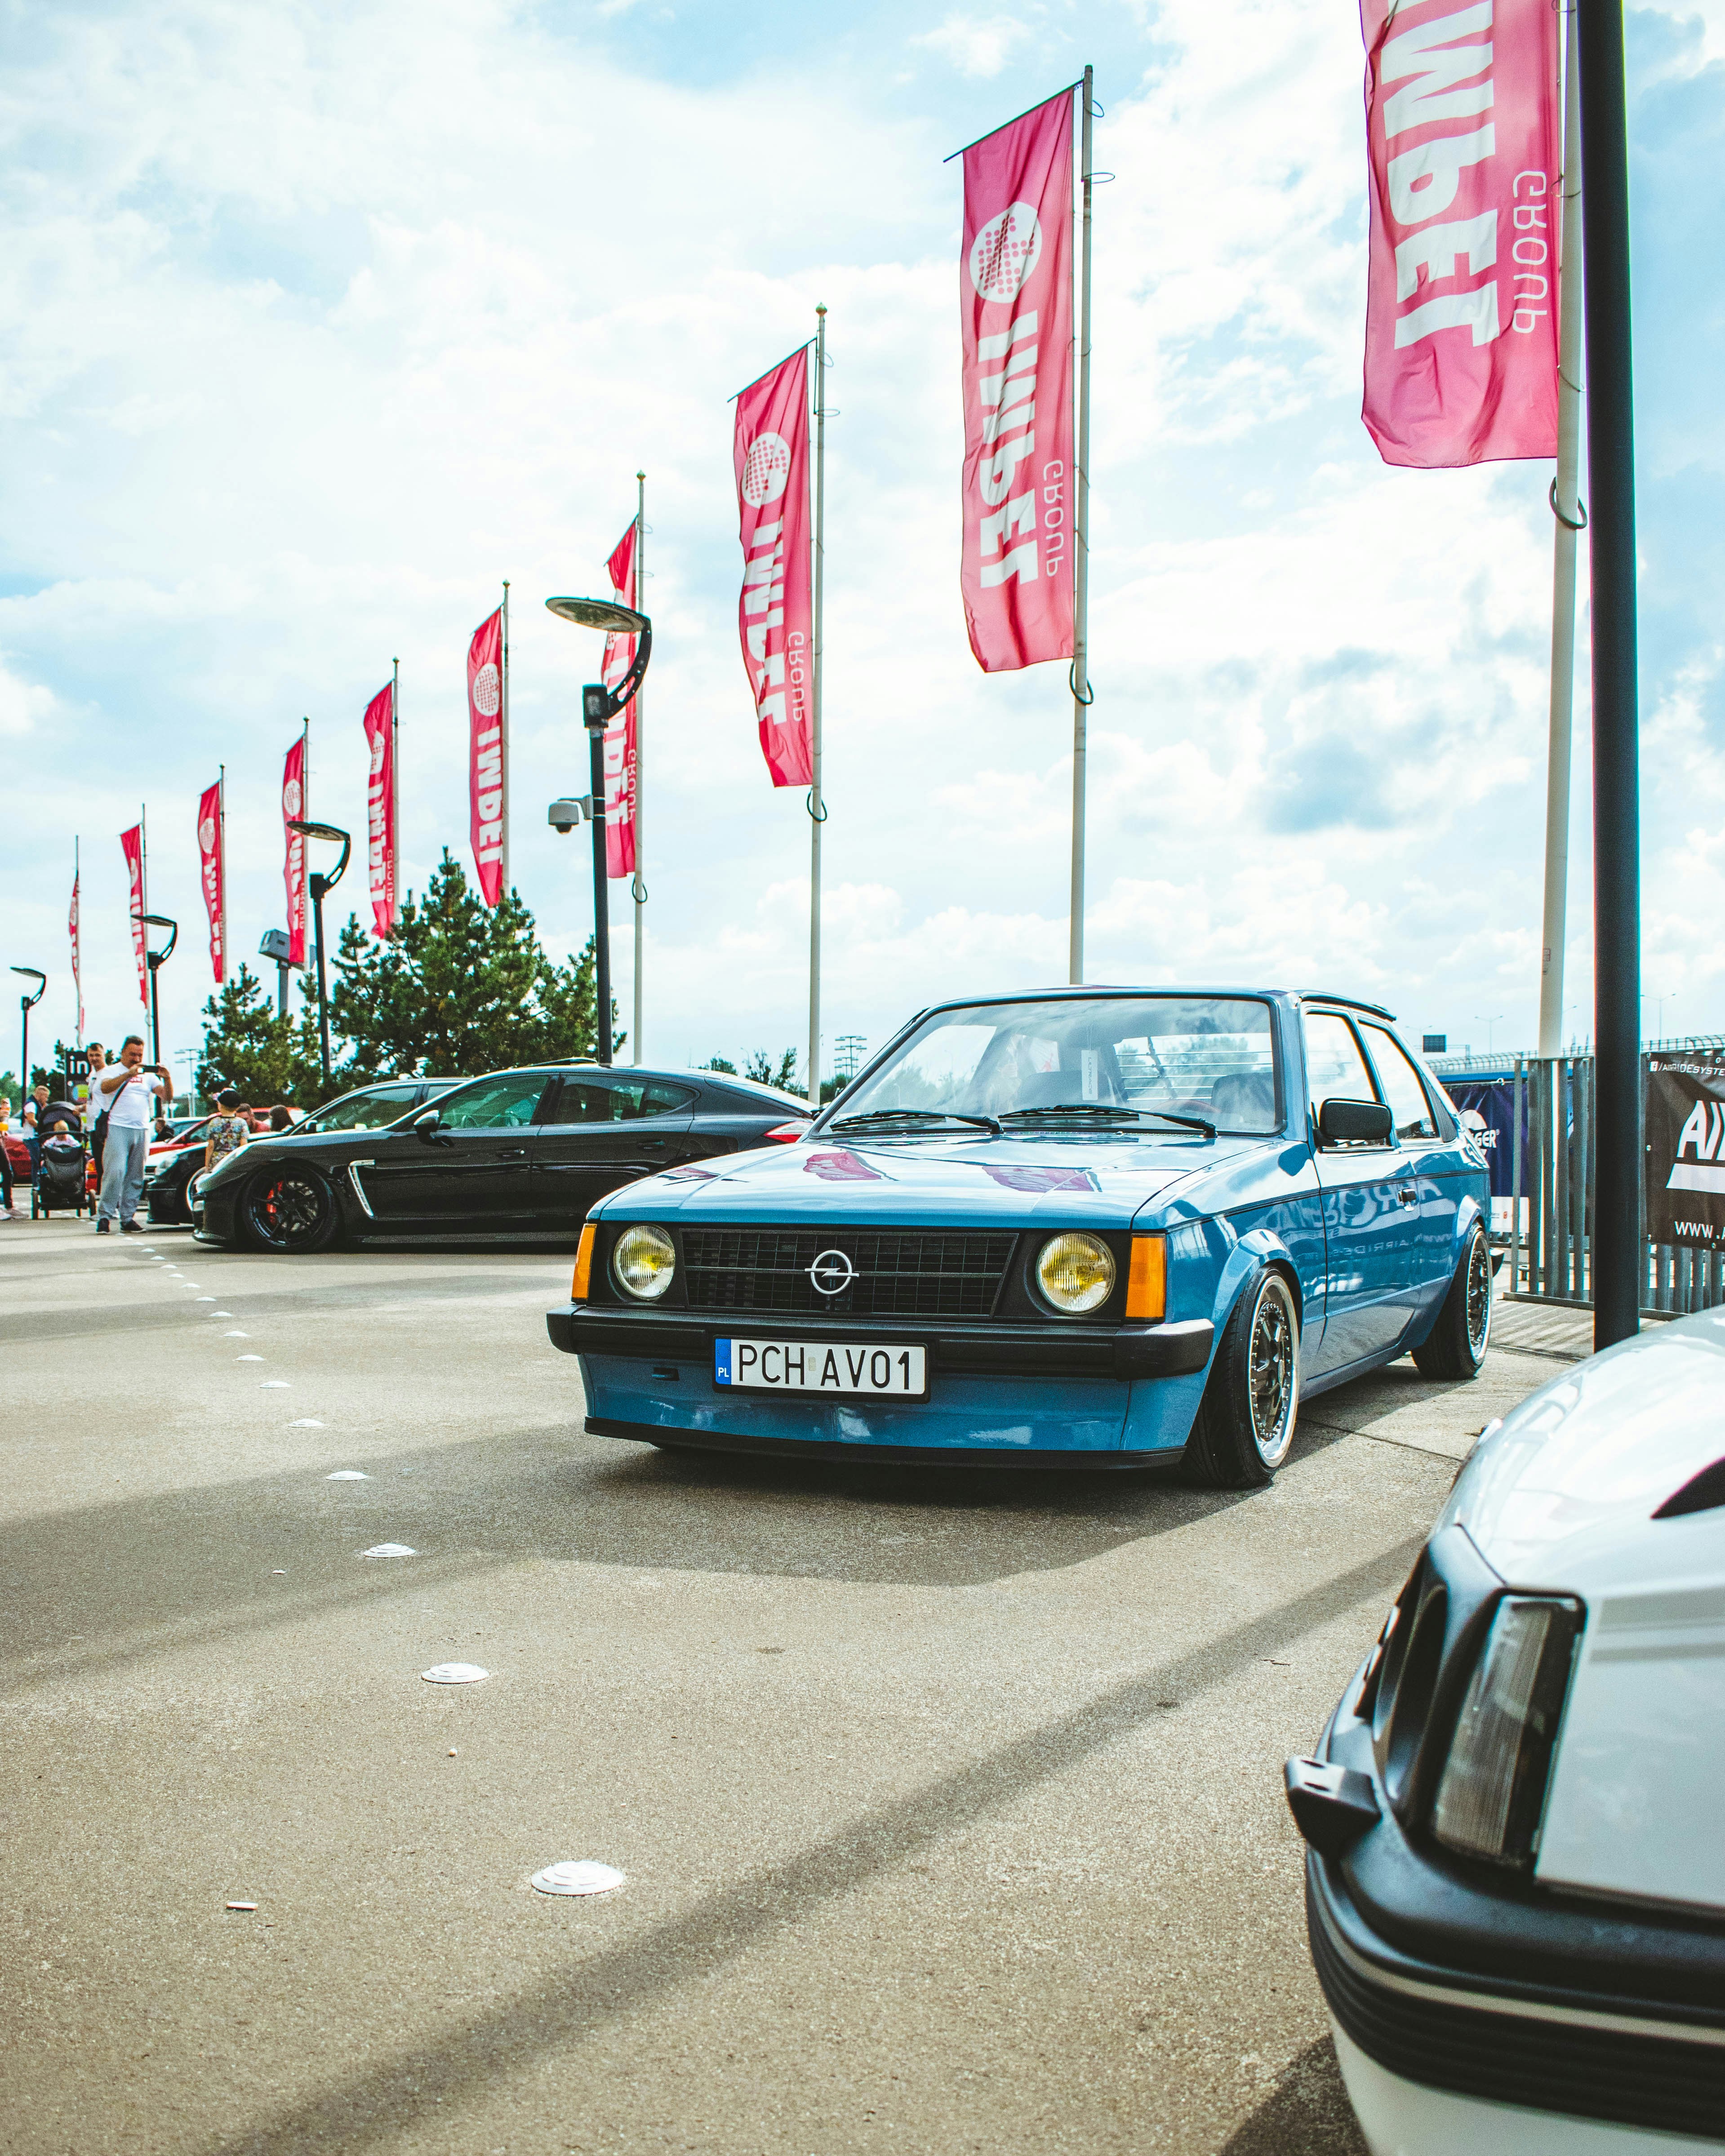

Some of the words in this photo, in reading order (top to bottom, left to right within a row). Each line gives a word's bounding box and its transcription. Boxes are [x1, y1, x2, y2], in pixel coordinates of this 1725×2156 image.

[1472, 1129, 1497, 1148] GER
[718, 1367, 729, 1378] PL
[739, 1344, 805, 1385] PCH
[820, 1348, 910, 1390] AV01
